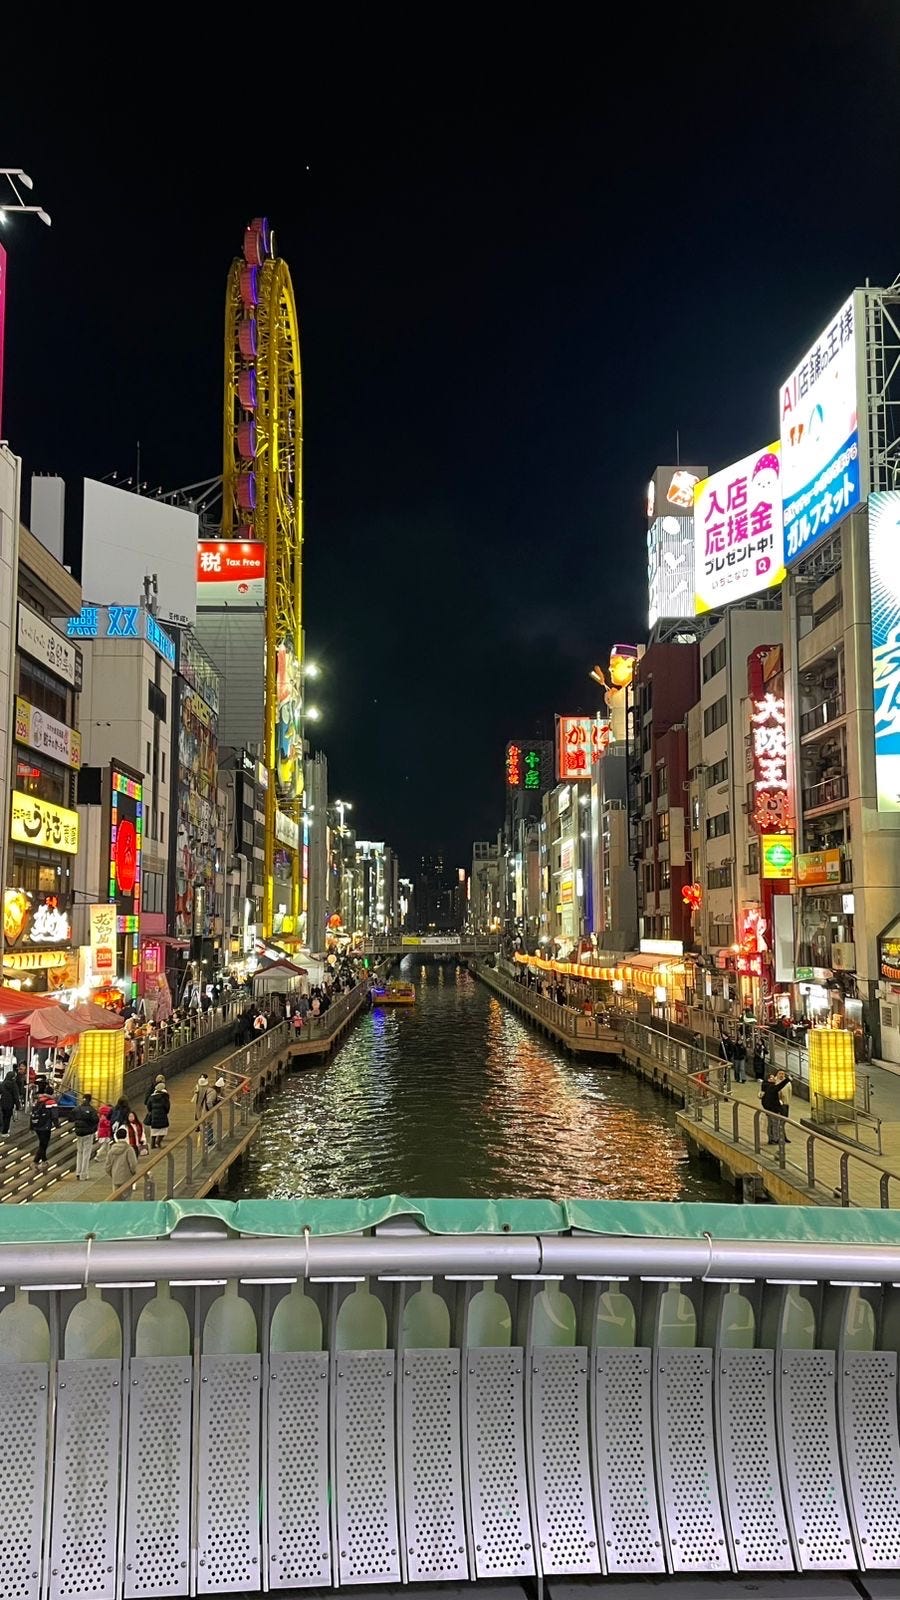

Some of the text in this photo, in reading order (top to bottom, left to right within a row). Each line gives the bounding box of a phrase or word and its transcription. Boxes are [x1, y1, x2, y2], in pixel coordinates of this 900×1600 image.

[704, 476, 748, 524] 入店
[786, 472, 855, 557] ガルフネット
[704, 500, 773, 557] 応援金
[200, 551, 222, 572] 税
[226, 557, 261, 567] Tax Free
